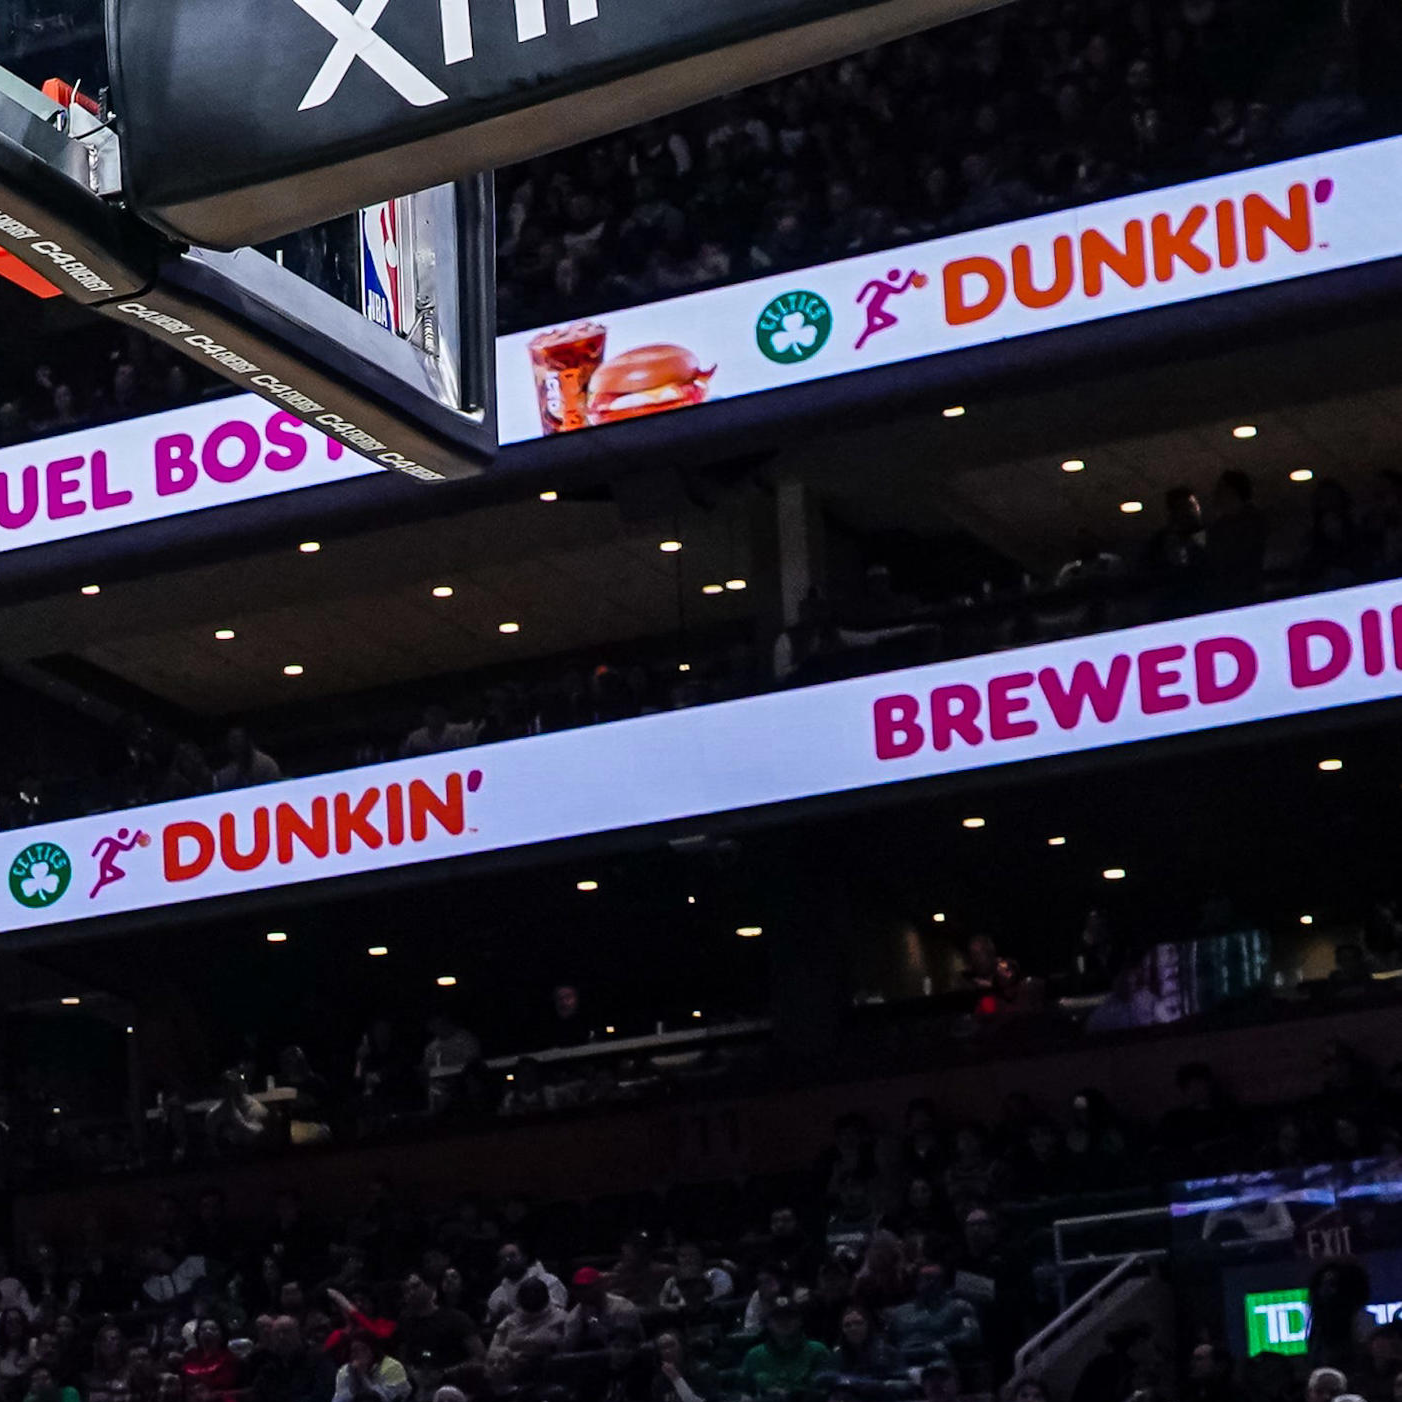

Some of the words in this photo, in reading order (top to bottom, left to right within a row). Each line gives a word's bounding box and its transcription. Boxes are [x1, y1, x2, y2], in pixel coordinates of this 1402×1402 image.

[31, 241, 76, 268] C4
[61, 260, 113, 292] ENERGY
[943, 179, 1332, 325] DUNKIN'
[117, 302, 154, 319] C4
[367, 289, 388, 327] NBA
[759, 295, 826, 330] CELTICS
[184, 334, 225, 357] C4
[251, 375, 288, 397] C4
[315, 414, 352, 436] C4
[378, 452, 415, 471] C4
[874, 637, 1257, 759] BREWED
[163, 770, 482, 881] DUNKIN'
[13, 846, 67, 876] CELTICS
